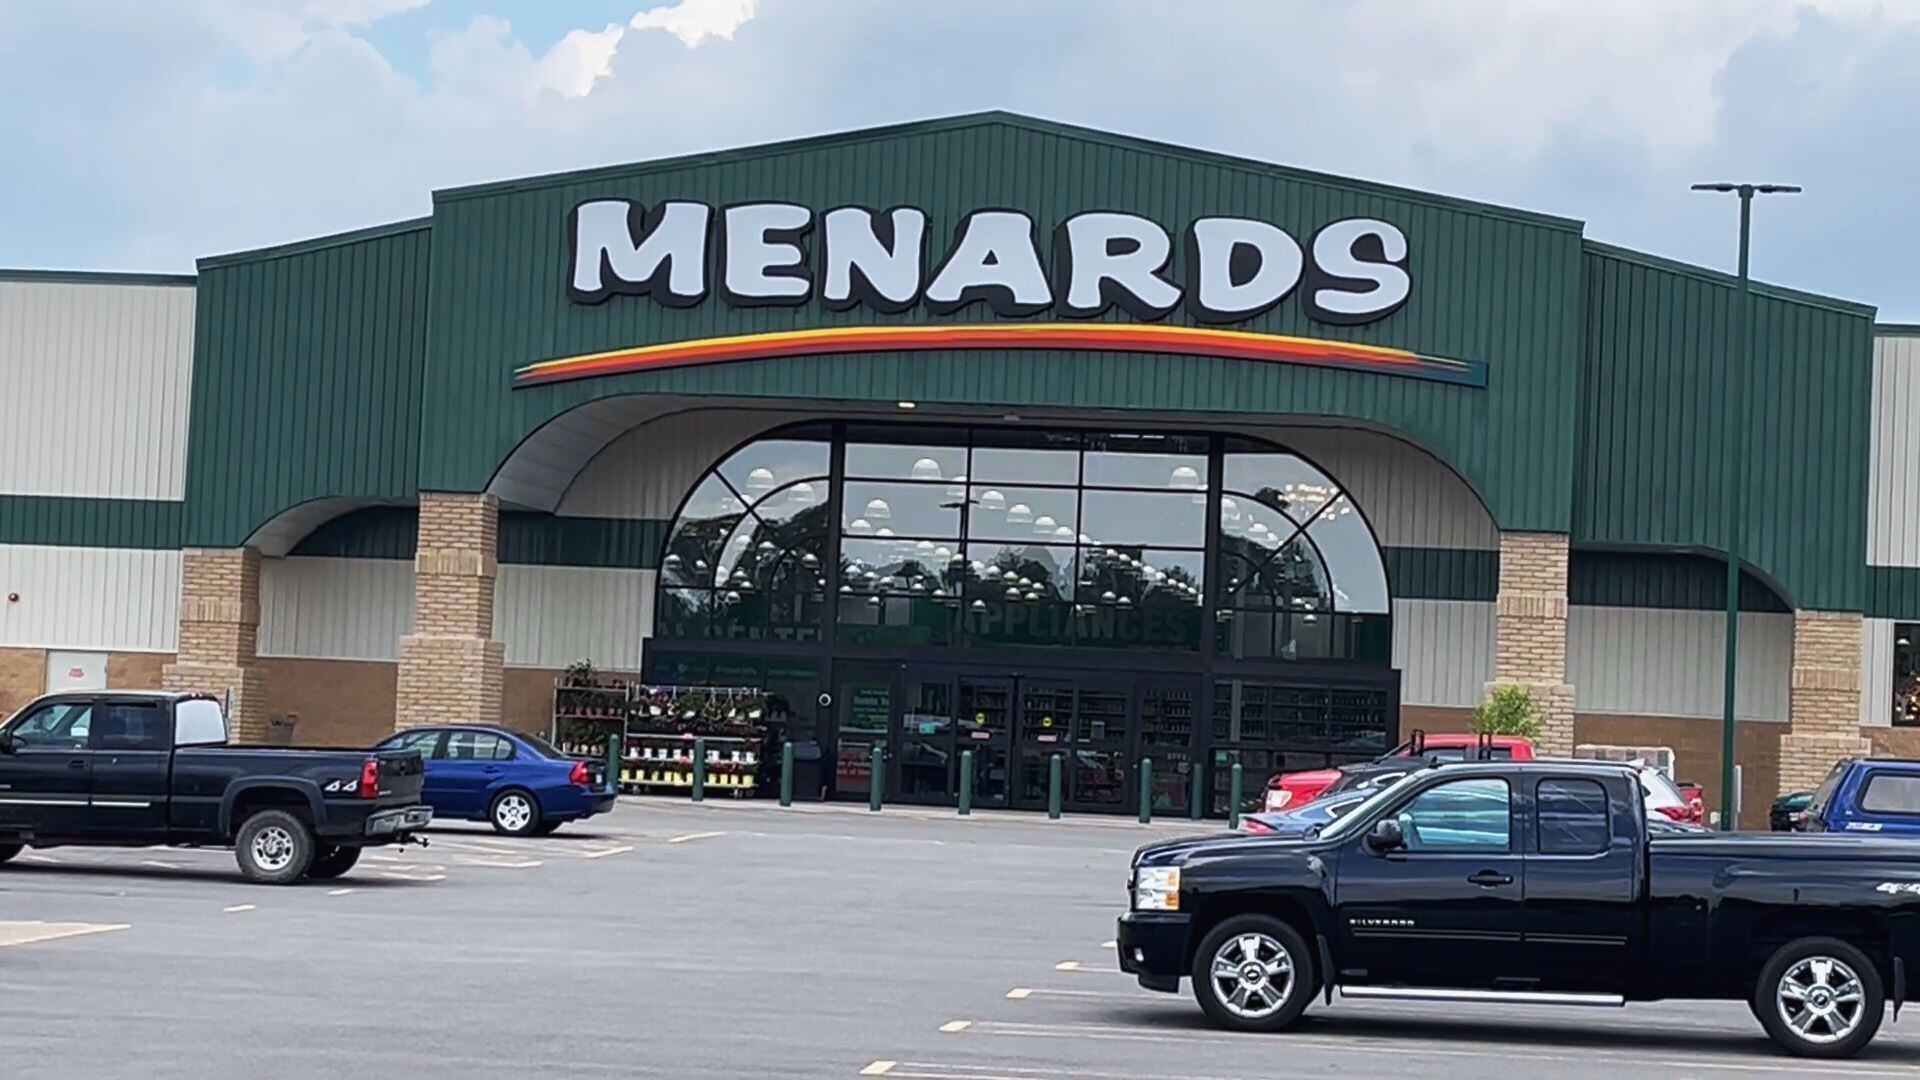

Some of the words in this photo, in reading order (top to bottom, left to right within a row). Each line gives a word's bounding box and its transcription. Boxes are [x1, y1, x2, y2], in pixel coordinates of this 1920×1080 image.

[569, 199, 1412, 320] MENARDS
[953, 602, 1187, 641] APPLIANCES
[325, 779, 358, 792] 44
